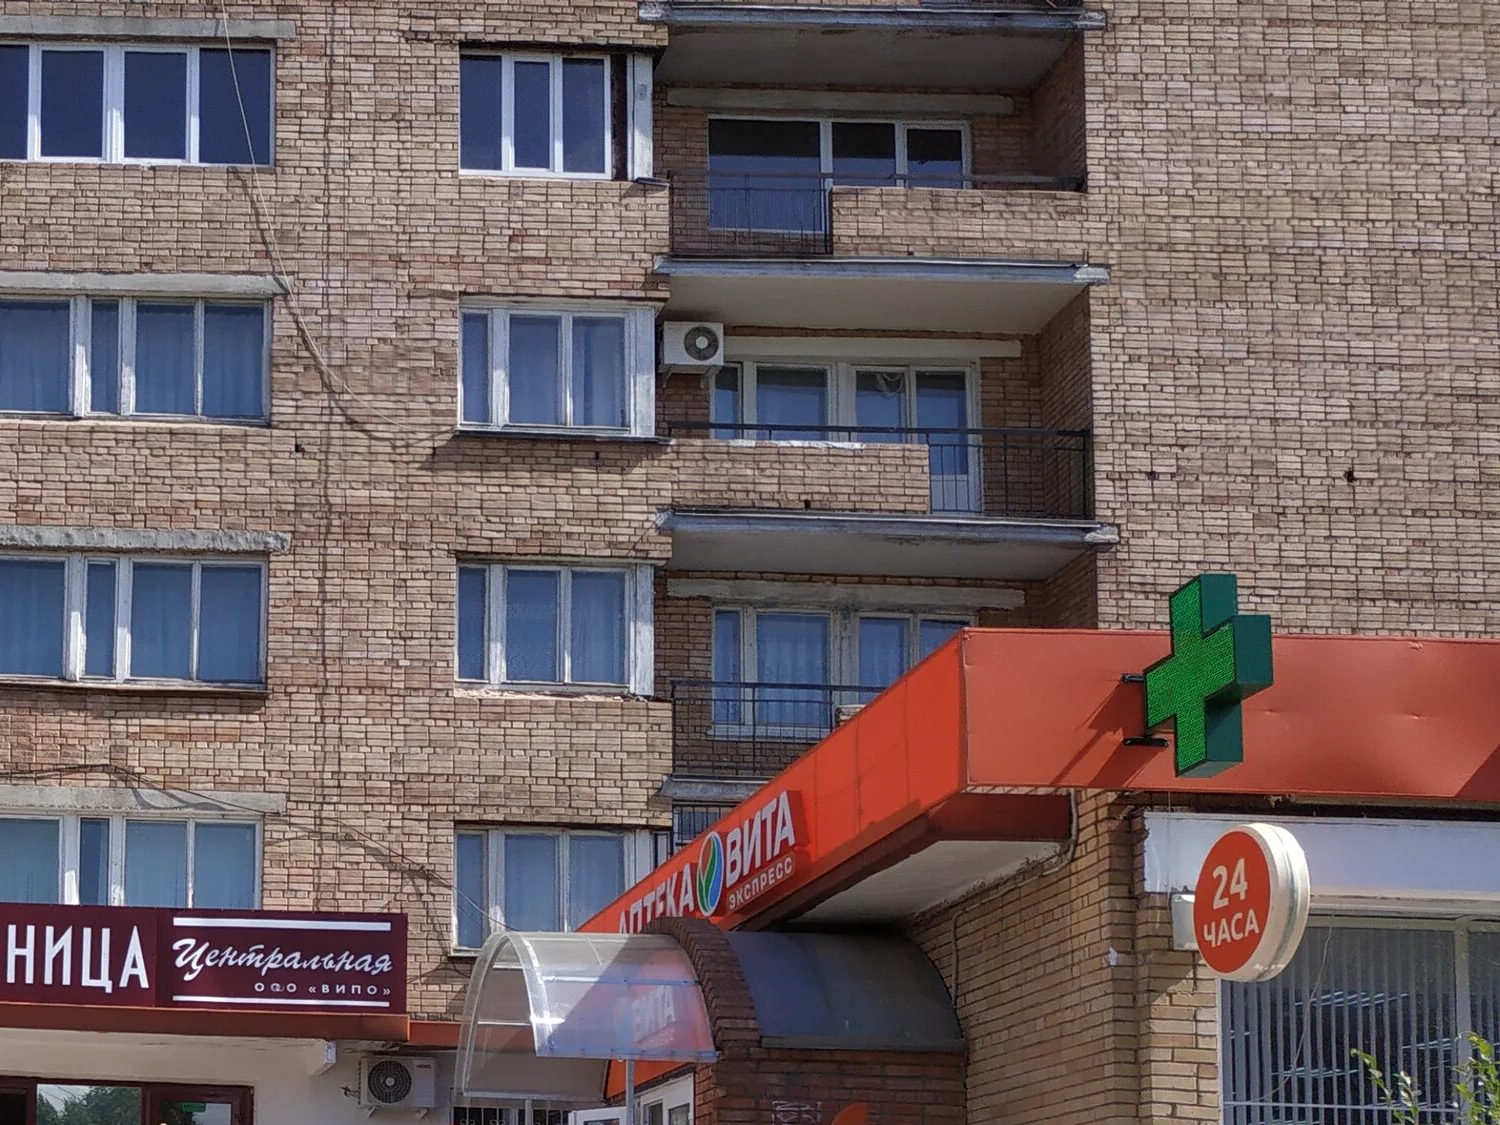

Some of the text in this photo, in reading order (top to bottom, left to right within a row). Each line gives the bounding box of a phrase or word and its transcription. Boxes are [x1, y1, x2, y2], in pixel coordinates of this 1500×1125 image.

[725, 791, 795, 888] ВИТА
[729, 856, 793, 910] ЭКСПРЕСС
[1212, 858, 1248, 910] 24
[1203, 908, 1260, 948] ЧАСА
[172, 938, 393, 982] Центральная
